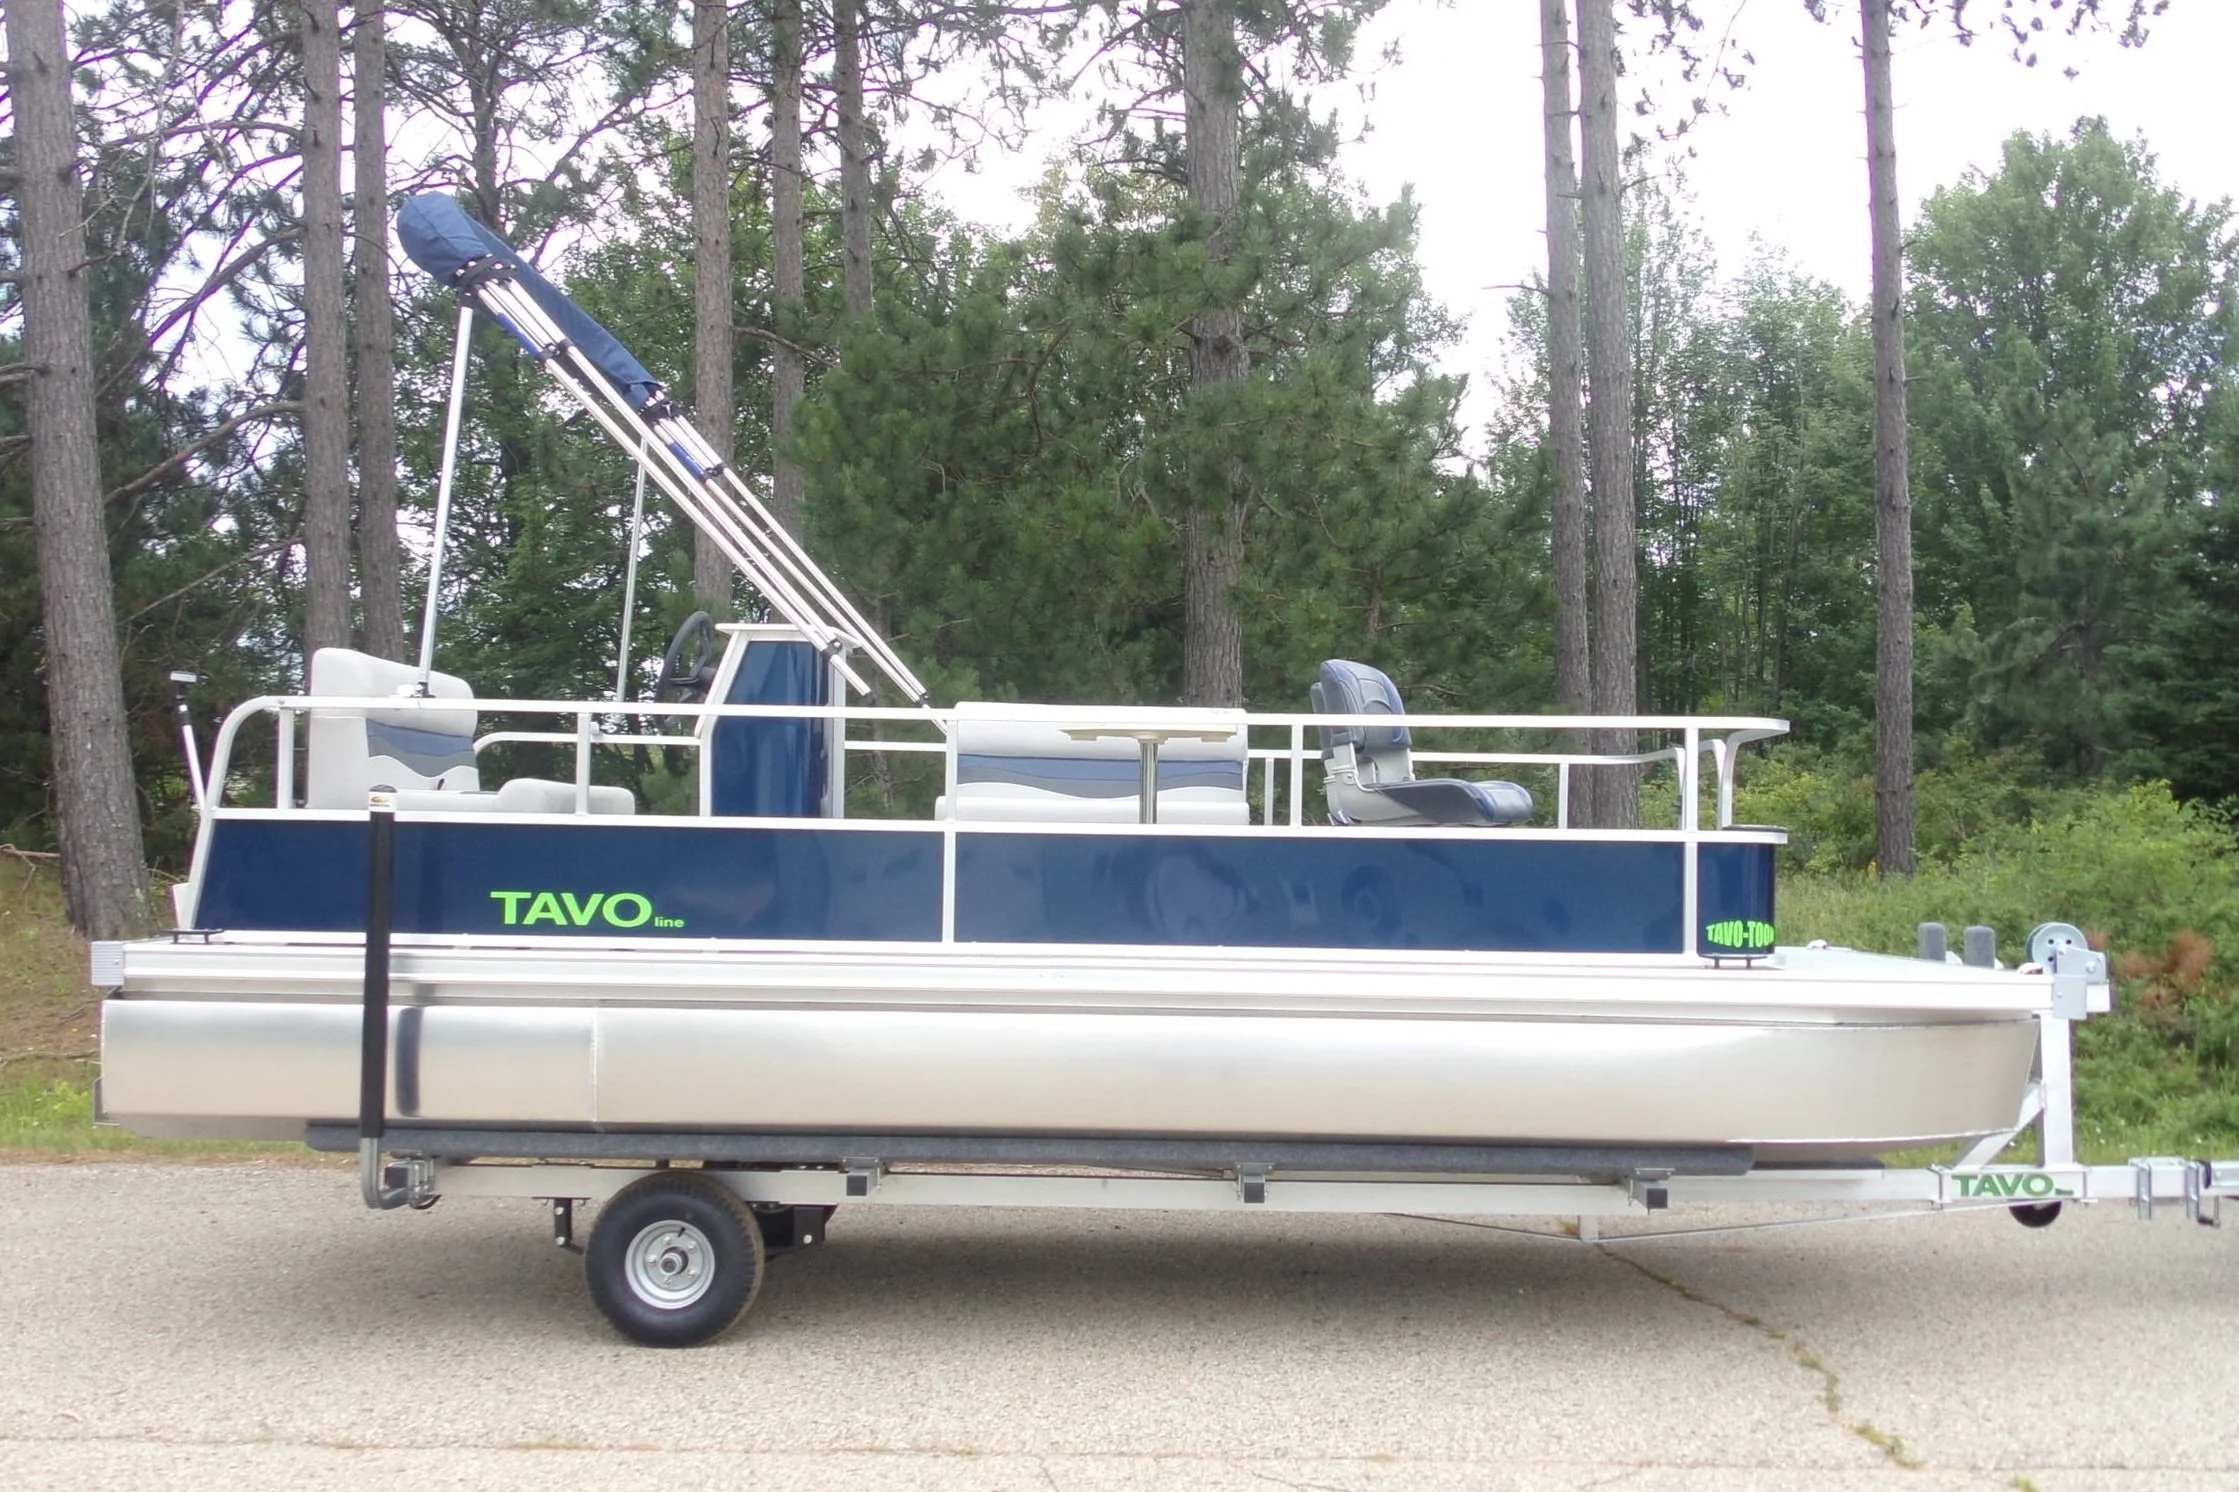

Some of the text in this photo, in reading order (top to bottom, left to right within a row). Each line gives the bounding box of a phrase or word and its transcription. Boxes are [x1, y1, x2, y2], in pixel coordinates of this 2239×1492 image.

[490, 891, 684, 928] TAVO line
[1951, 1173, 2054, 1197] TAVO
